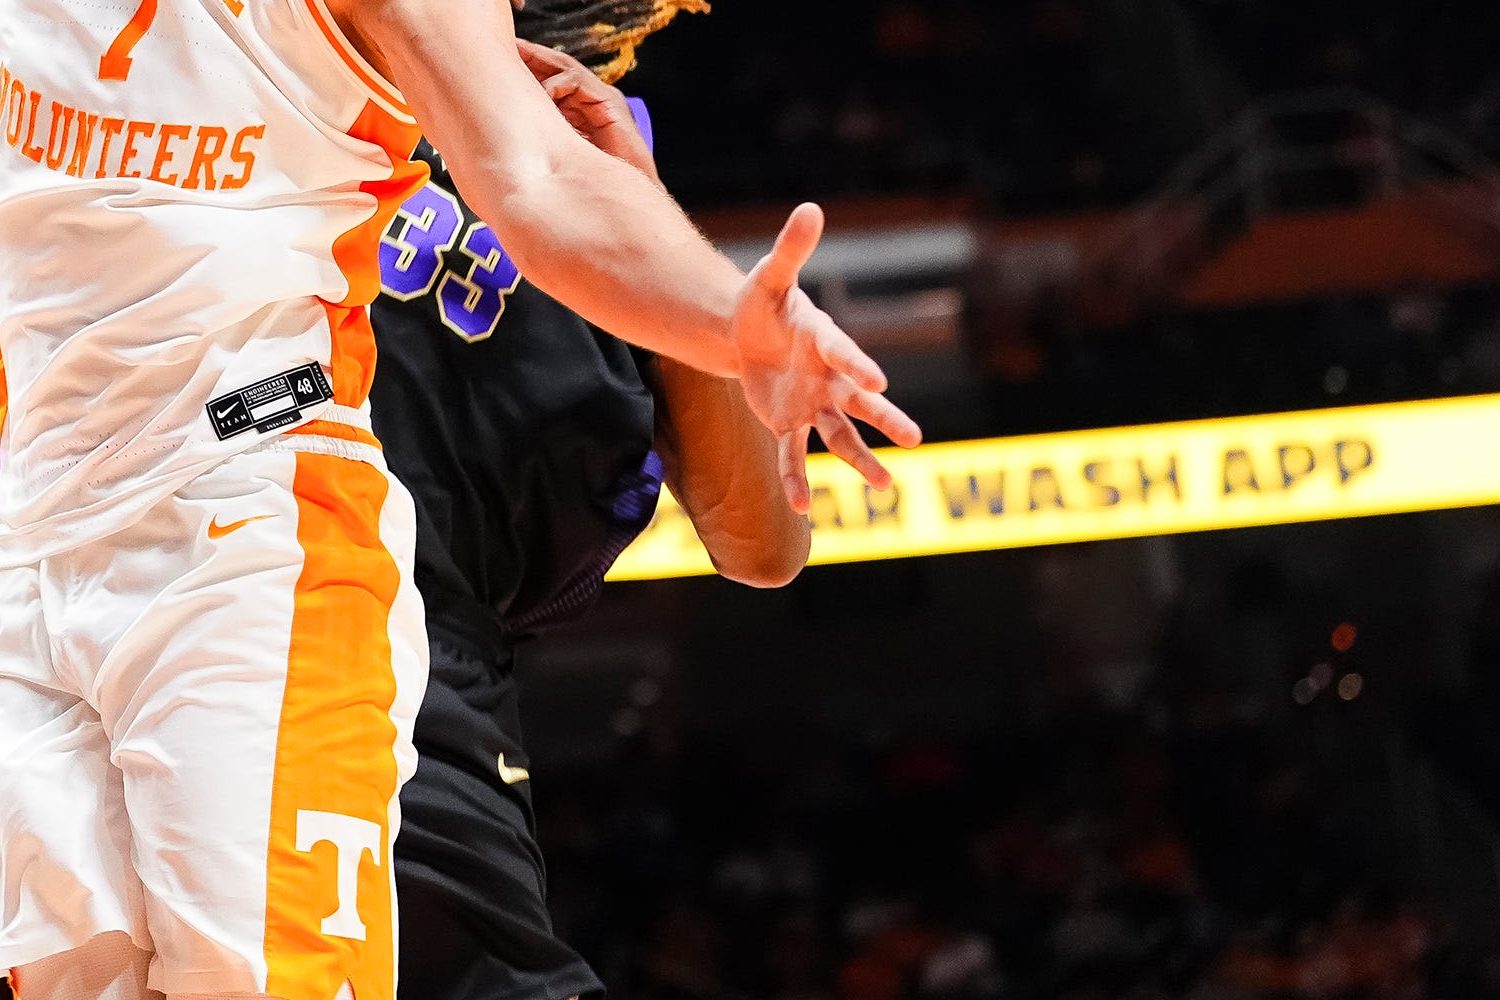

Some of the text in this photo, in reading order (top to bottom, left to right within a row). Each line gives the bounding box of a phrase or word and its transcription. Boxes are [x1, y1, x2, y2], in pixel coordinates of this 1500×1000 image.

[378, 180, 522, 343] 33
[220, 414, 247, 429] TEAM
[297, 377, 314, 395] 48
[804, 437, 1374, 531] AR WASH APP
[296, 809, 381, 941] T
